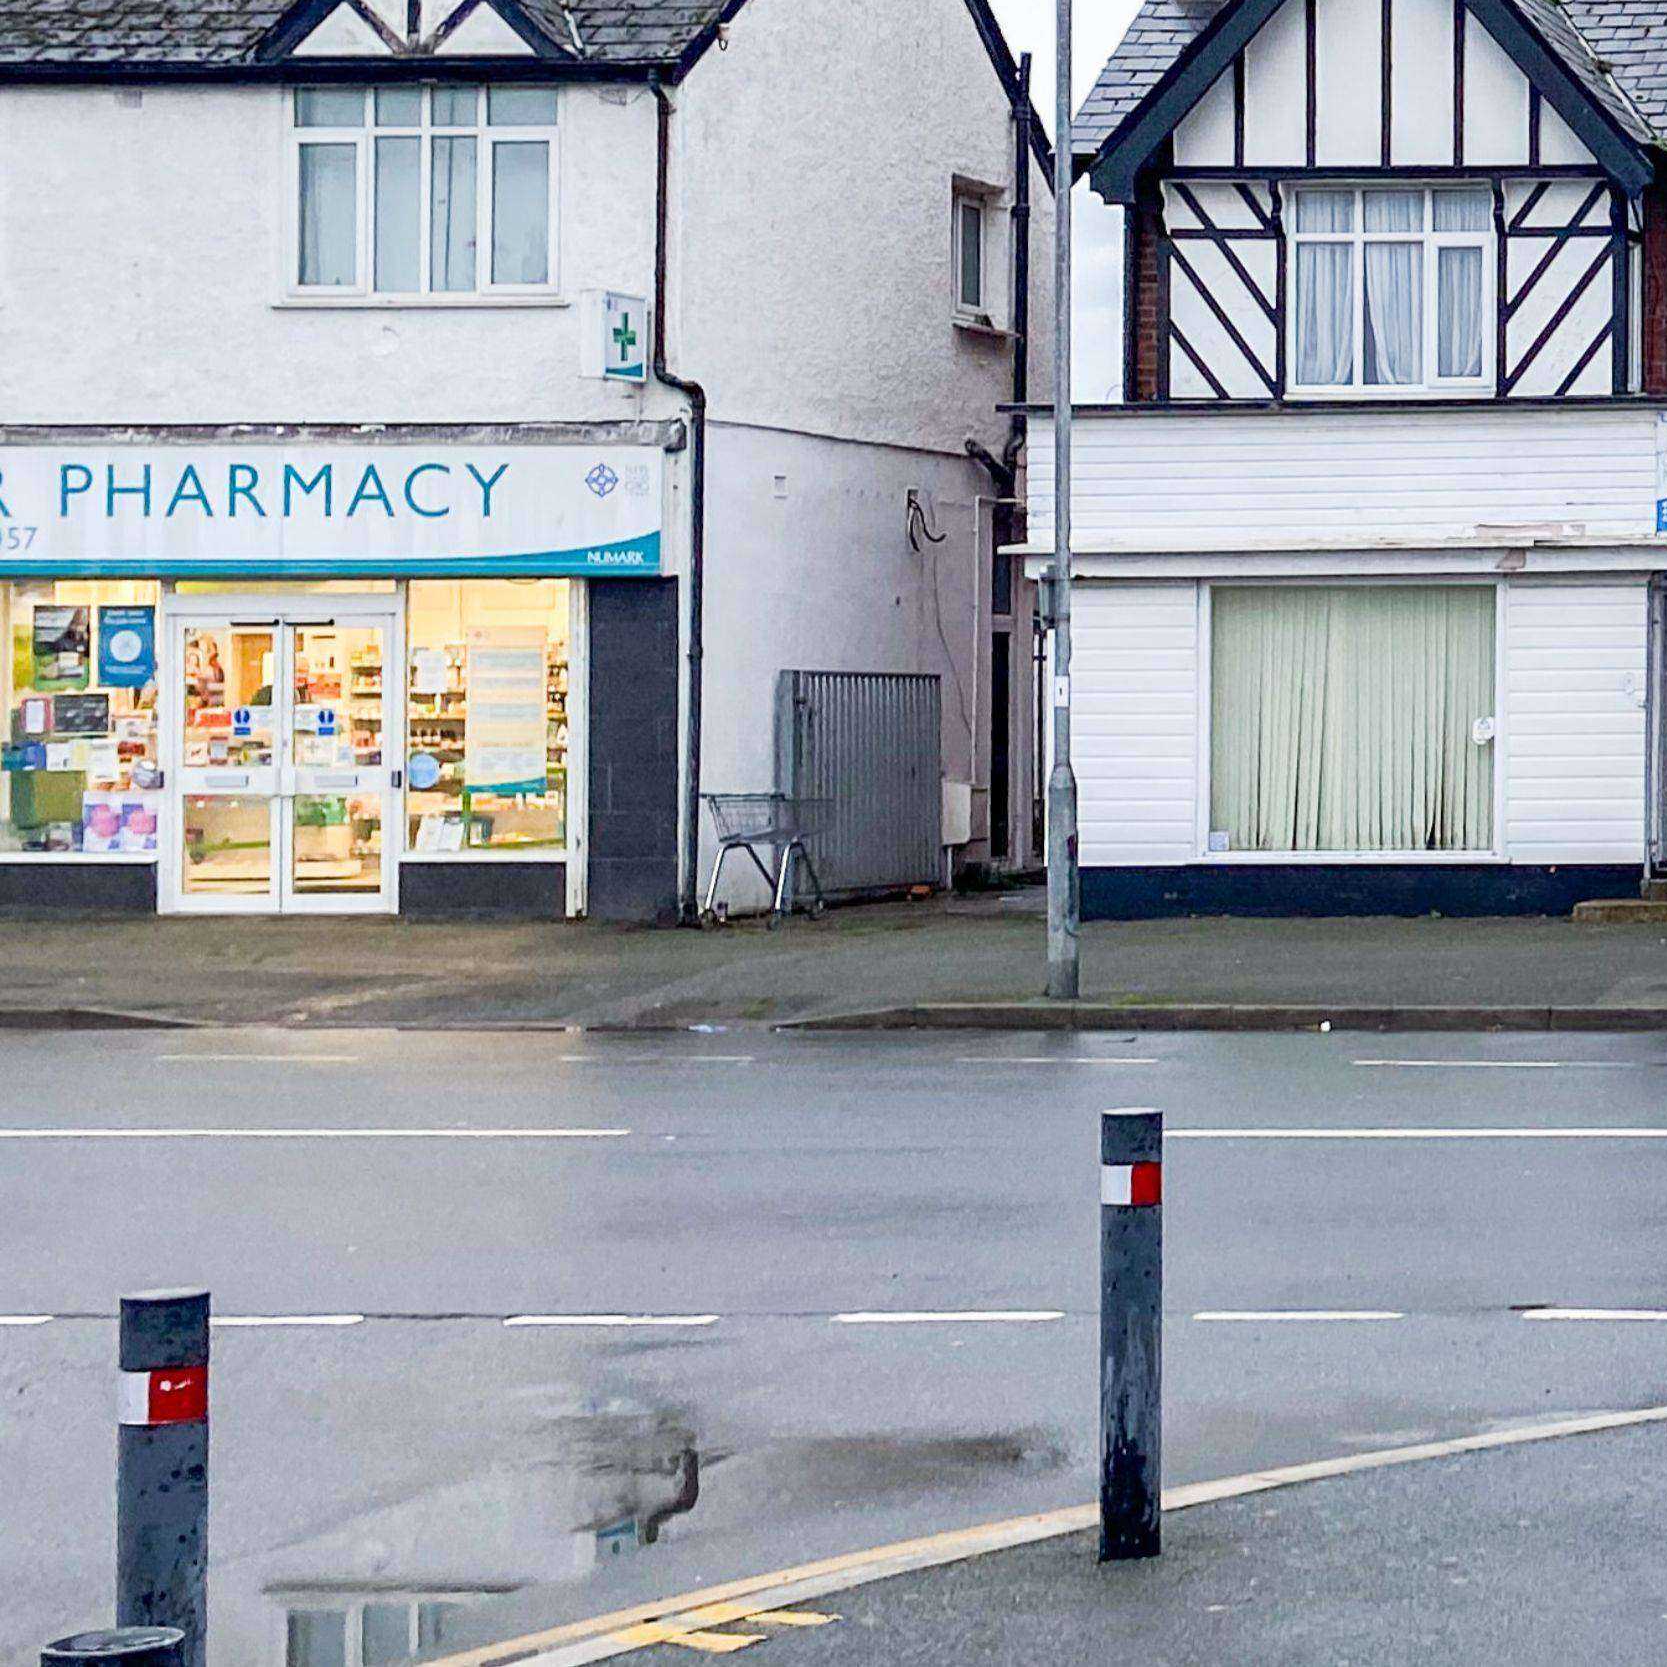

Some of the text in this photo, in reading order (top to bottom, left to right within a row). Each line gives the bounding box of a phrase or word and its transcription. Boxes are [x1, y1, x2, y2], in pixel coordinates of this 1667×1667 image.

[60, 464, 509, 518] PHARMACY
[0, 526, 37, 550] 57
[587, 551, 644, 566] NUMARK
